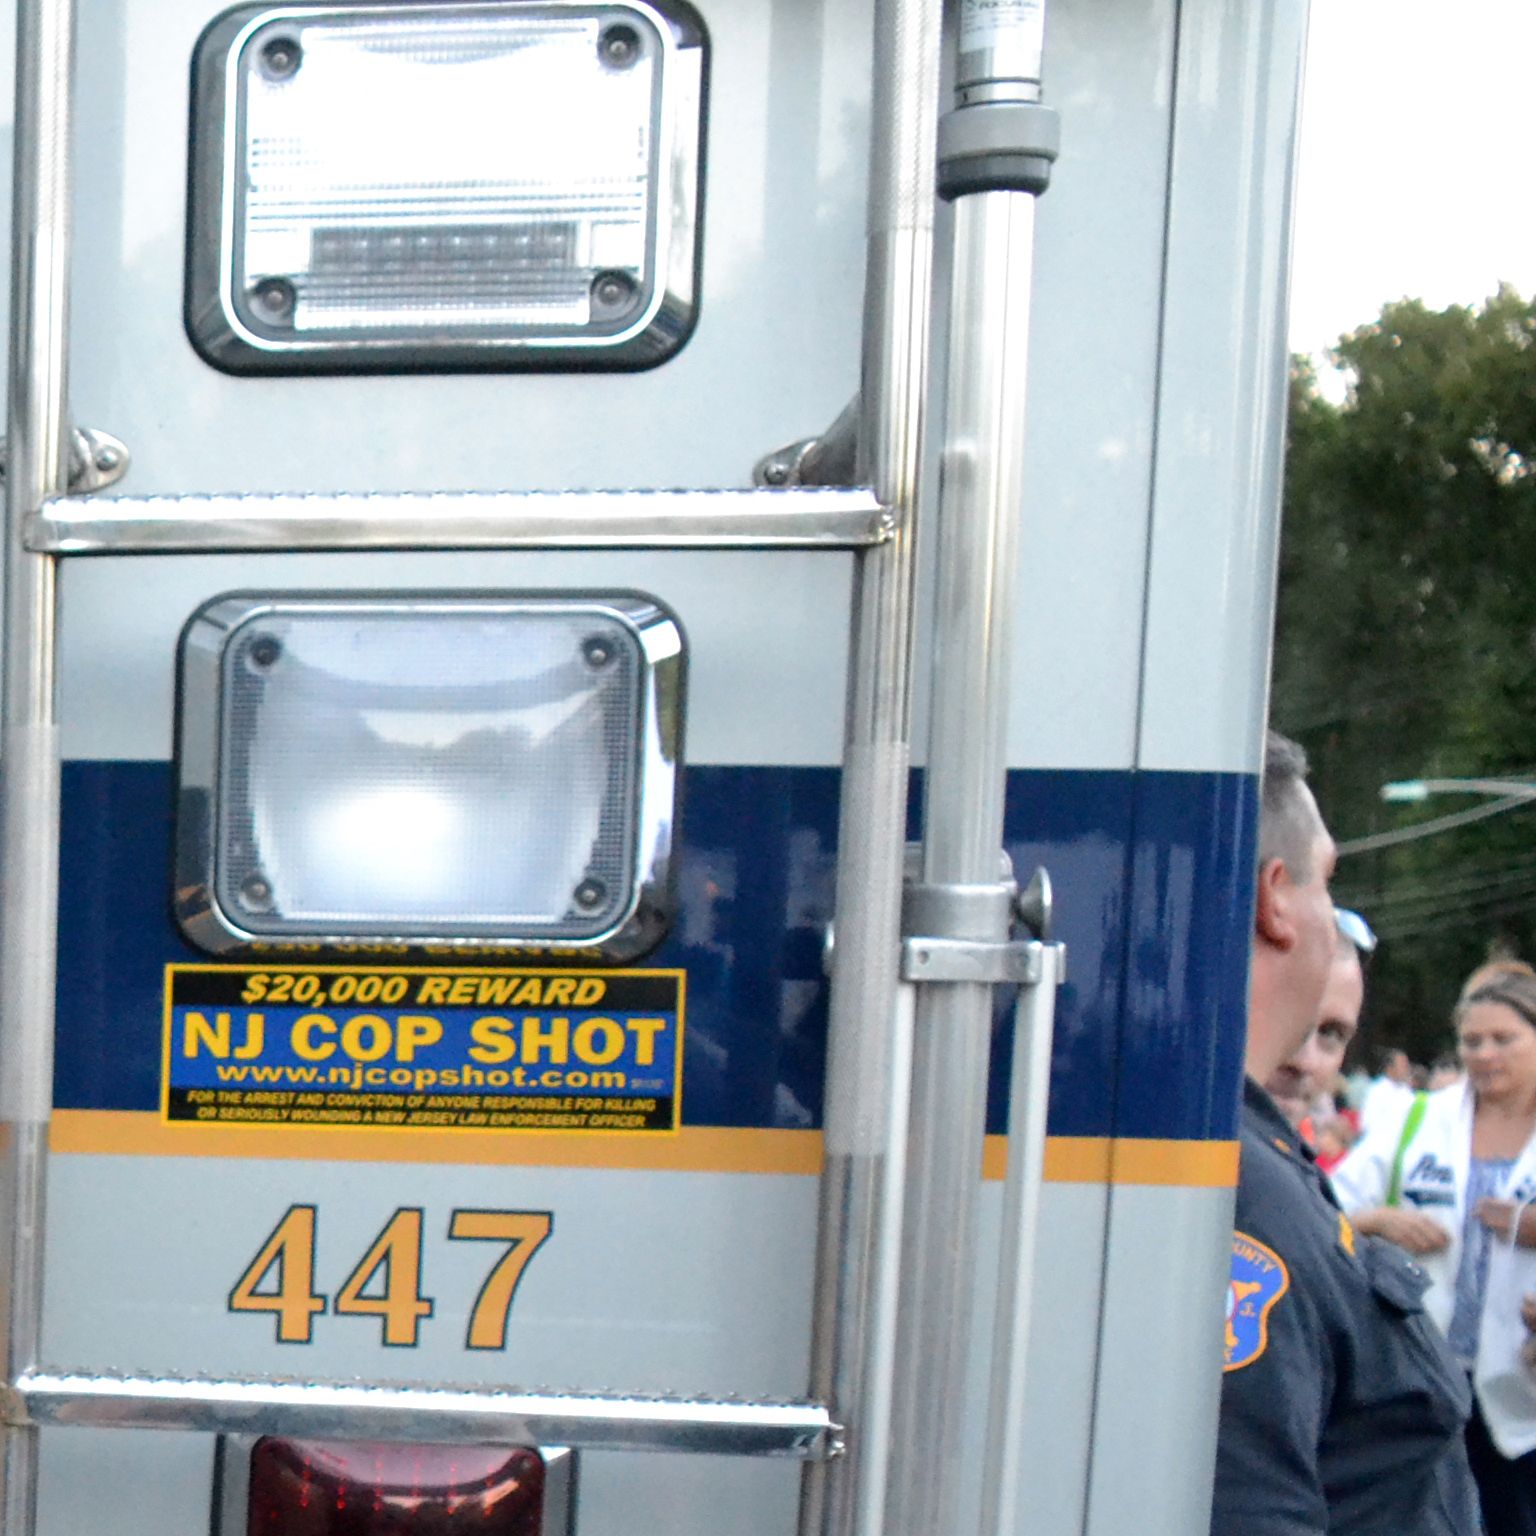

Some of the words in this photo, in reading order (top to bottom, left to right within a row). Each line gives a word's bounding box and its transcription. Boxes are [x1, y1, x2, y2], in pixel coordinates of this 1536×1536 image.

[241, 973, 408, 1008] $20,000
[417, 976, 607, 1006] REWARD
[183, 1012, 265, 1059] NJ
[290, 1014, 443, 1063] COP
[468, 1015, 666, 1066] SHOT
[216, 1062, 626, 1090] www.njcopshot.com
[187, 1090, 215, 1103] FOR
[217, 1091, 242, 1104] THE
[243, 1091, 295, 1105] ARREST
[296, 1092, 325, 1106] AND
[326, 1093, 405, 1108] CONVICTION
[407, 1095, 425, 1108] OF
[427, 1095, 480, 1109] ANYONE
[482, 1096, 576, 1111] RESPONSIBLE
[577, 1097, 603, 1111] FOR
[604, 1098, 656, 1112] KILLING
[197, 1106, 217, 1119] OR
[218, 1107, 289, 1121] SERIOUSLY
[291, 1108, 361, 1122] WOUNDING
[362, 1110, 373, 1122] A
[374, 1110, 407, 1123] NEW
[407, 1111, 458, 1125] JERSEY
[459, 1112, 487, 1125] LAW
[488, 1112, 588, 1126] ENFORCEMENT
[228, 1203, 555, 1352] 447
